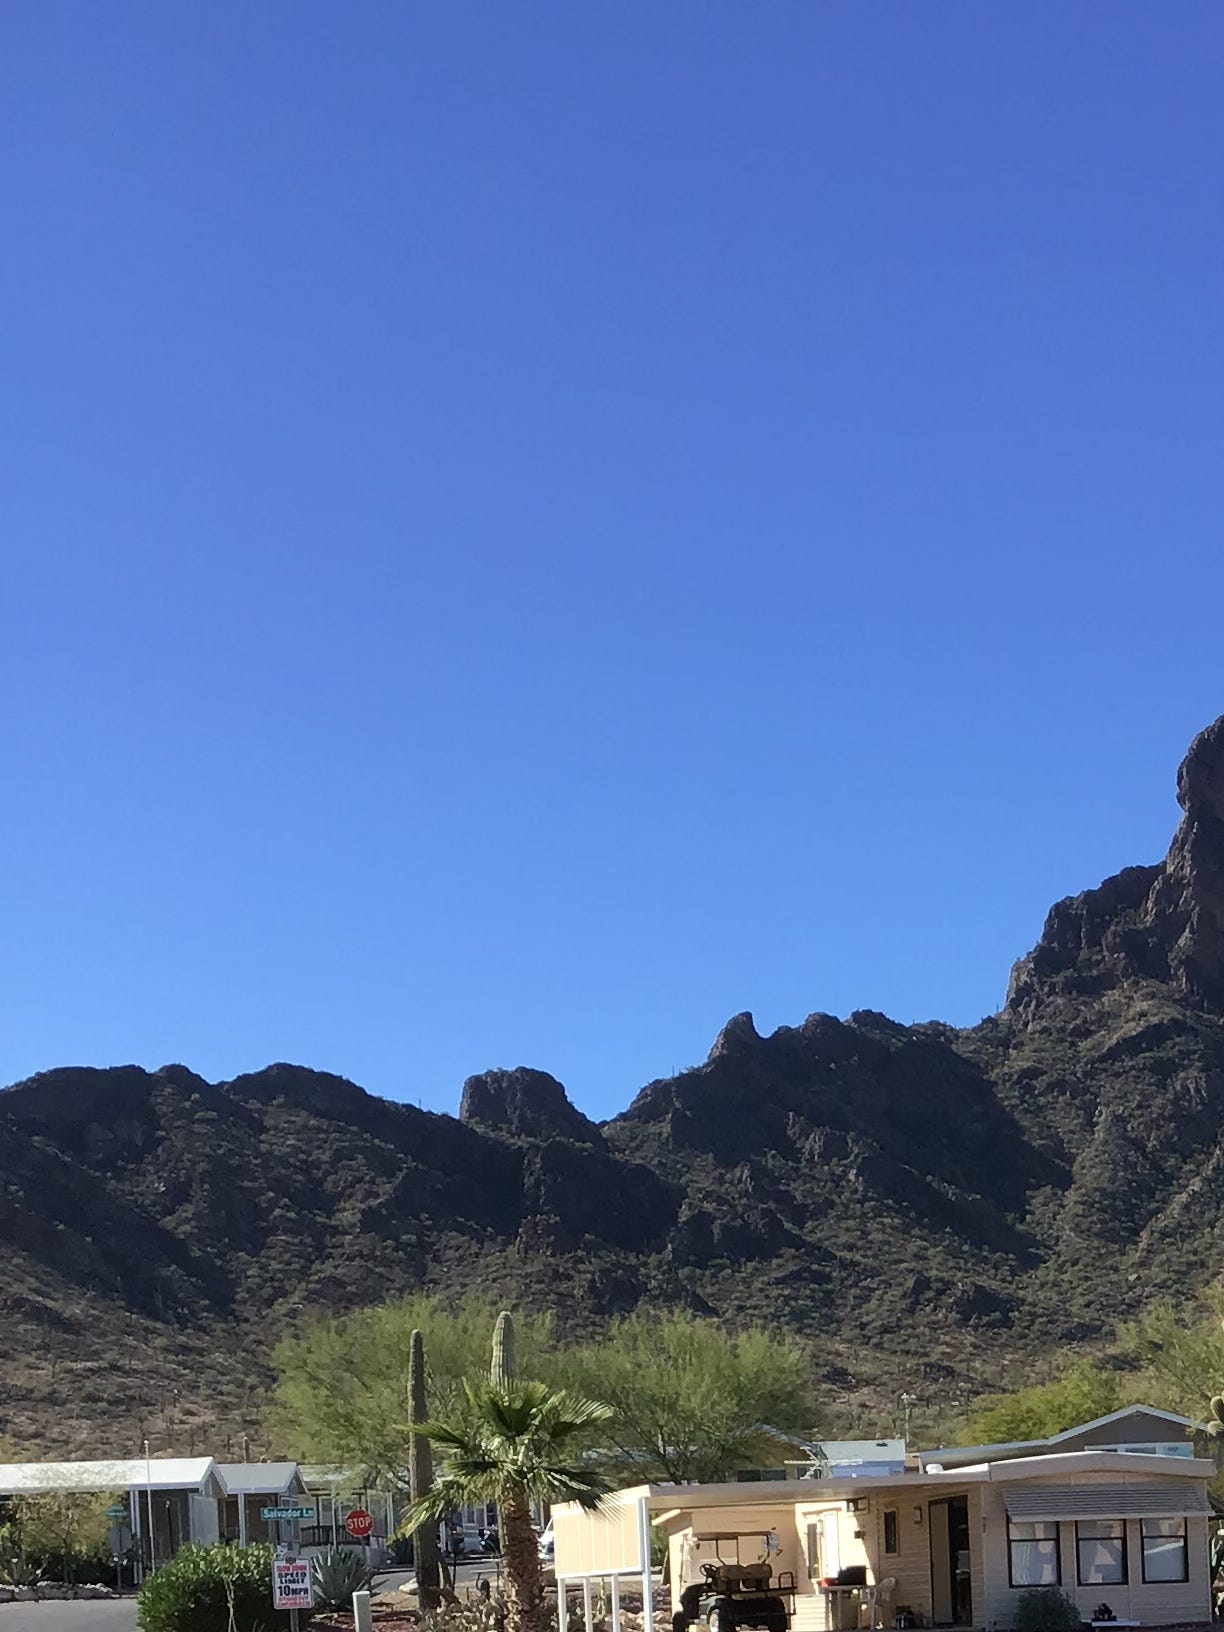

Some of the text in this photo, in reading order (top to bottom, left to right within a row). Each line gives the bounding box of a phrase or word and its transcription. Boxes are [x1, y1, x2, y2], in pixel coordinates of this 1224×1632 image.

[263, 1508, 301, 1519] Salvador
[347, 1517, 371, 1530] STOP
[277, 1585, 309, 1596] 10 MPH
